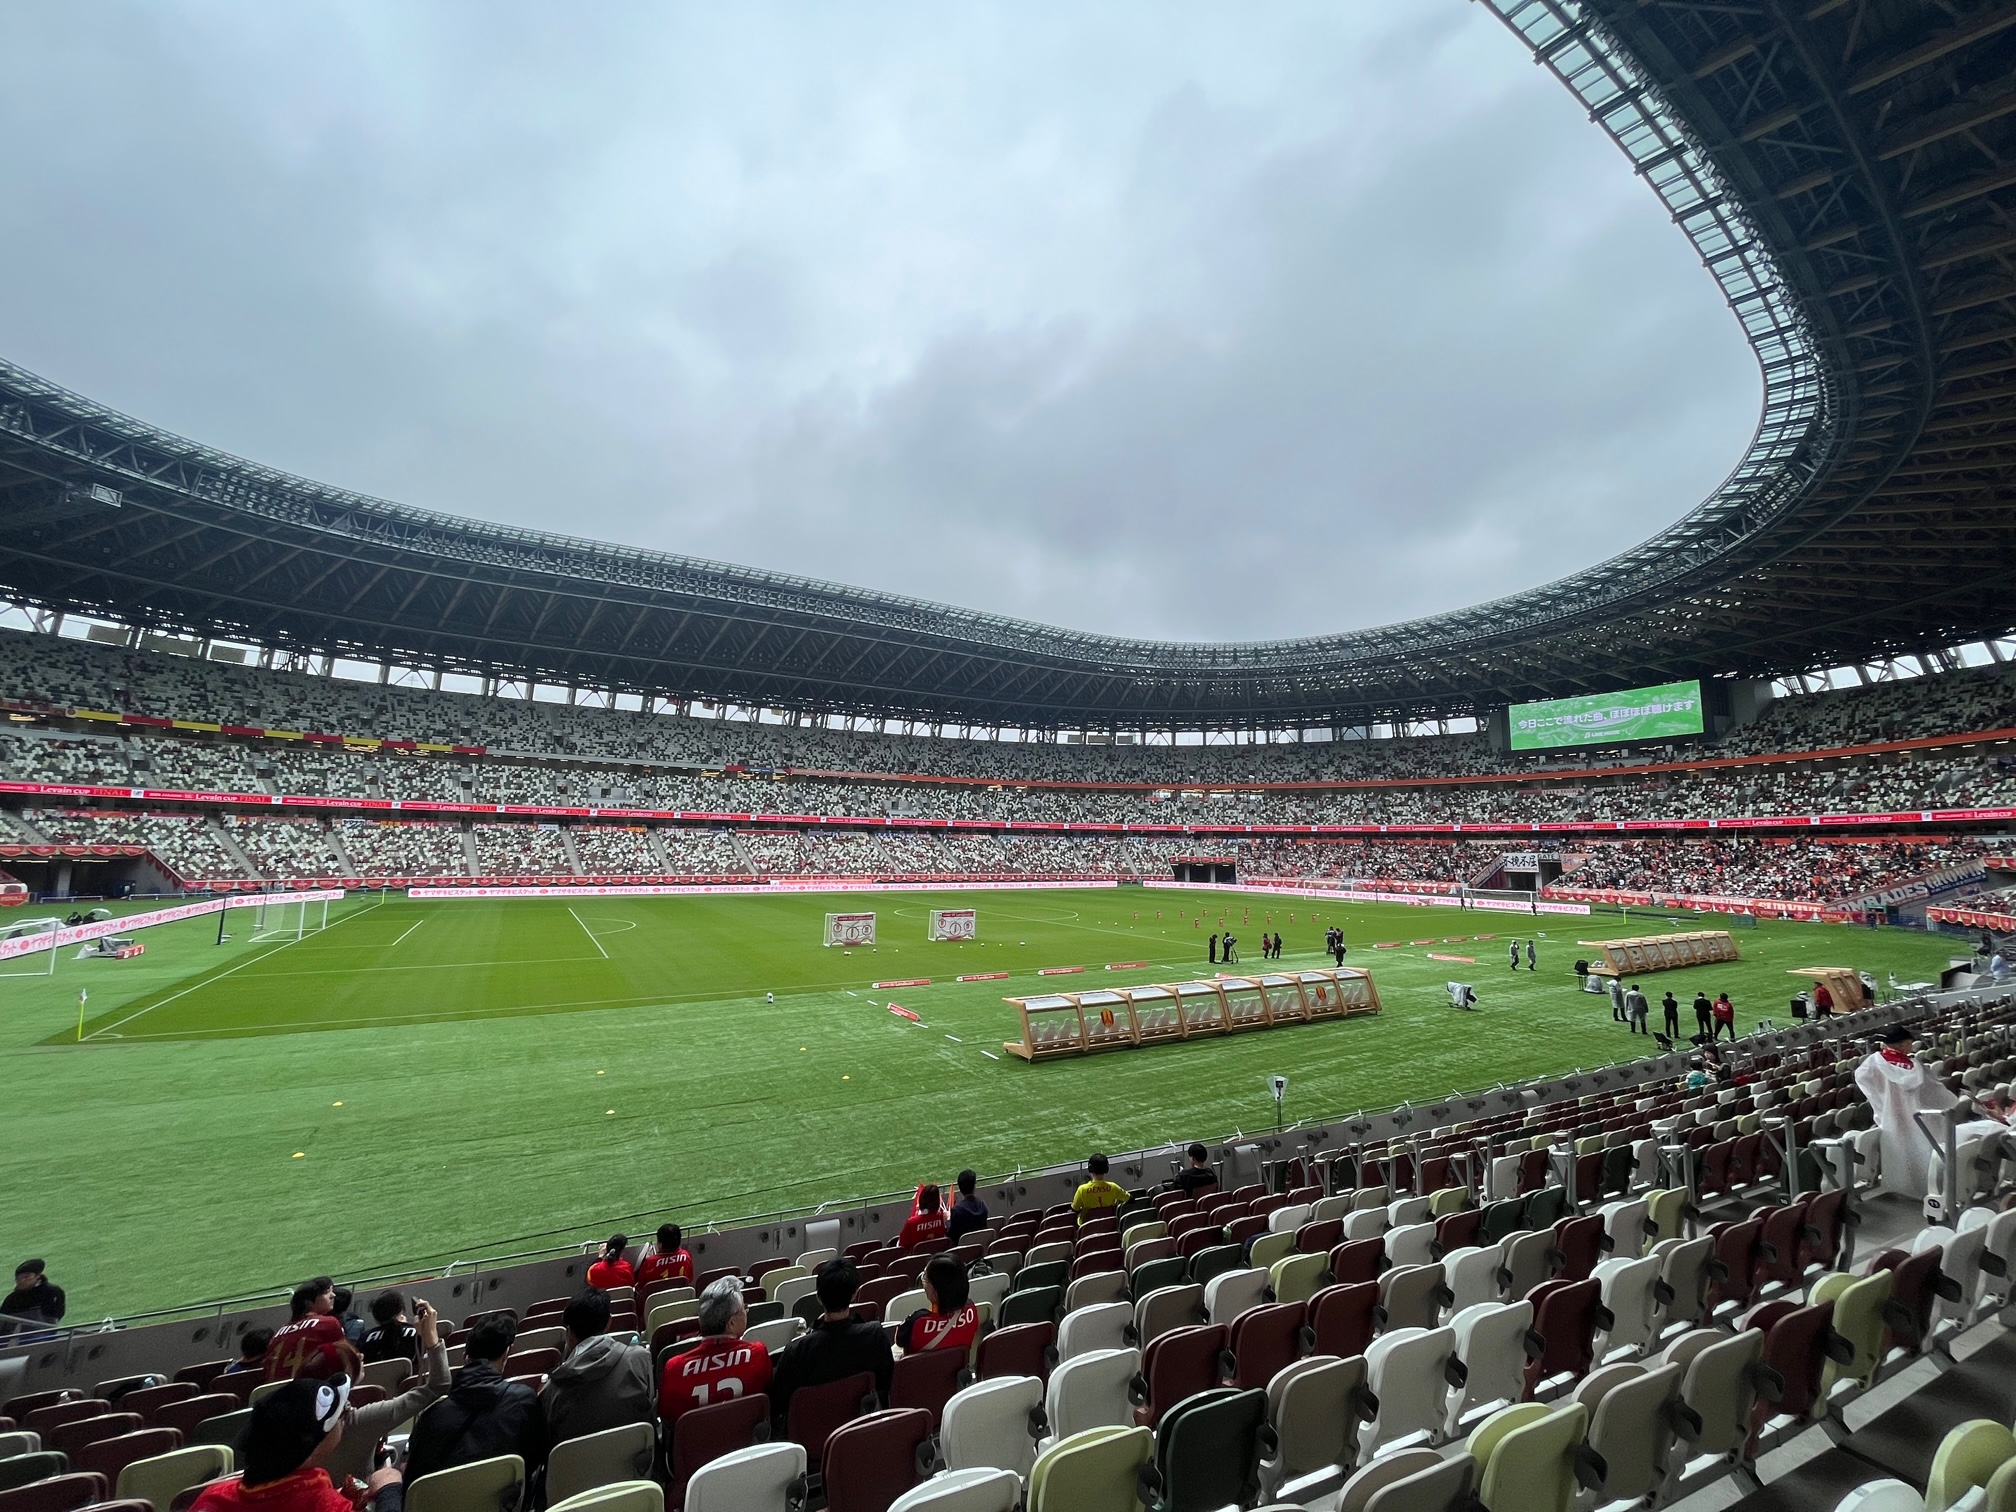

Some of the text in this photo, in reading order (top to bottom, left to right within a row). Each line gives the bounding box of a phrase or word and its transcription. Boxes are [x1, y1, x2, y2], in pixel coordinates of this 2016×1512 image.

[1087, 1185, 1112, 1194] DENSO
[917, 1219, 942, 1232] AISIN
[656, 1254, 687, 1267] AISIN
[682, 1348, 751, 1377] AISIN
